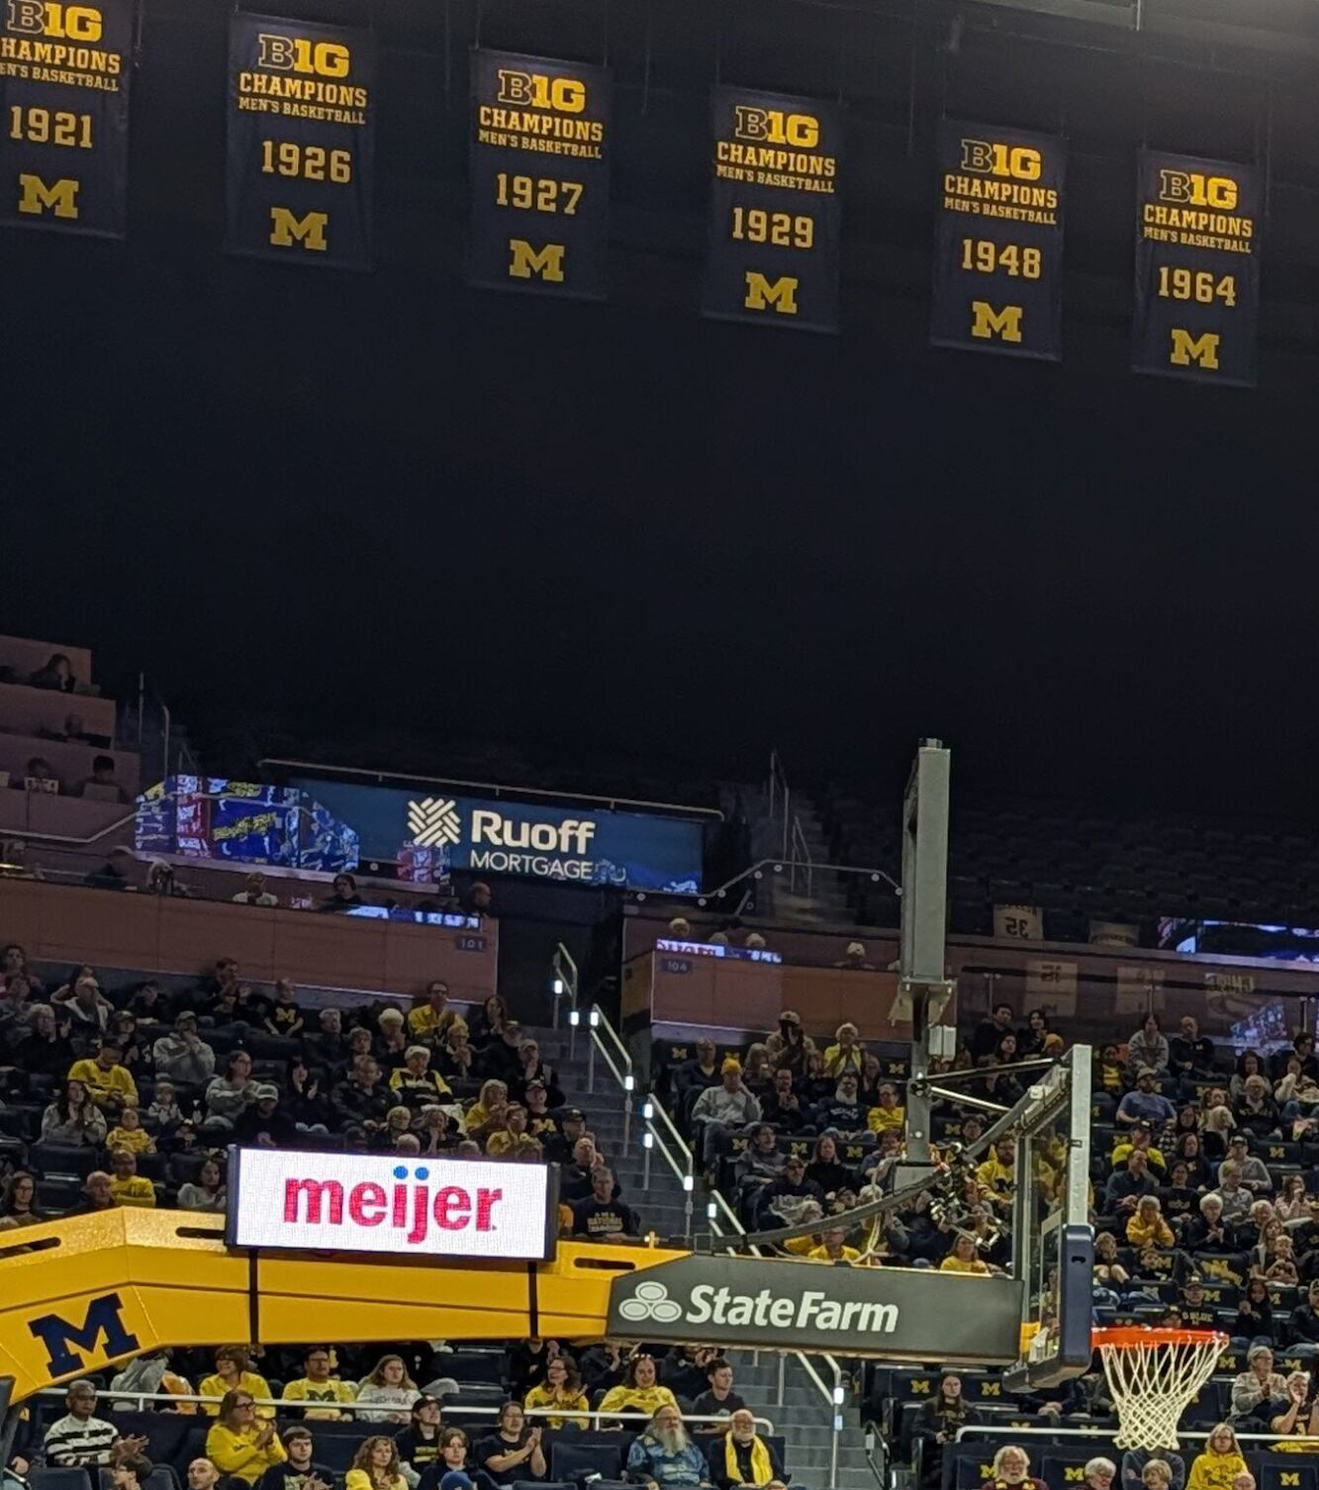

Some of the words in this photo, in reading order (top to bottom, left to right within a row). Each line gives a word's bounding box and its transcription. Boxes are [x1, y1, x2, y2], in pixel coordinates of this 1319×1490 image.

[0, 39, 121, 74] HAMPIONS
[31, 64, 119, 91] BASKETBALL
[238, 73, 365, 107] CHAMPIONS
[11, 106, 91, 148] 1921
[238, 94, 281, 113] MEN'S
[282, 100, 364, 123] BASKETBALL
[480, 106, 602, 143] CHAMPIONS
[264, 141, 351, 184] 1926
[477, 128, 519, 147] MEN'S
[520, 134, 600, 158] BASKETBALL
[717, 142, 834, 176] CHAMPIONS
[20, 174, 79, 217] M
[497, 173, 584, 213] 1927
[944, 176, 1057, 210] CHAMPIONS
[270, 207, 328, 250] M
[733, 208, 813, 248] 1929
[1144, 204, 1253, 239] CHAMPIONS
[510, 240, 564, 282] M
[963, 238, 1041, 279] 1948
[745, 273, 798, 312] M
[1159, 268, 1235, 306] 1964
[972, 301, 1022, 341] M
[1171, 329, 1219, 369] M
[471, 809, 596, 854] Ruoff
[470, 849, 593, 881] MORTGAGE
[283, 1166, 503, 1243] meijer
[27, 1292, 141, 1379] M
